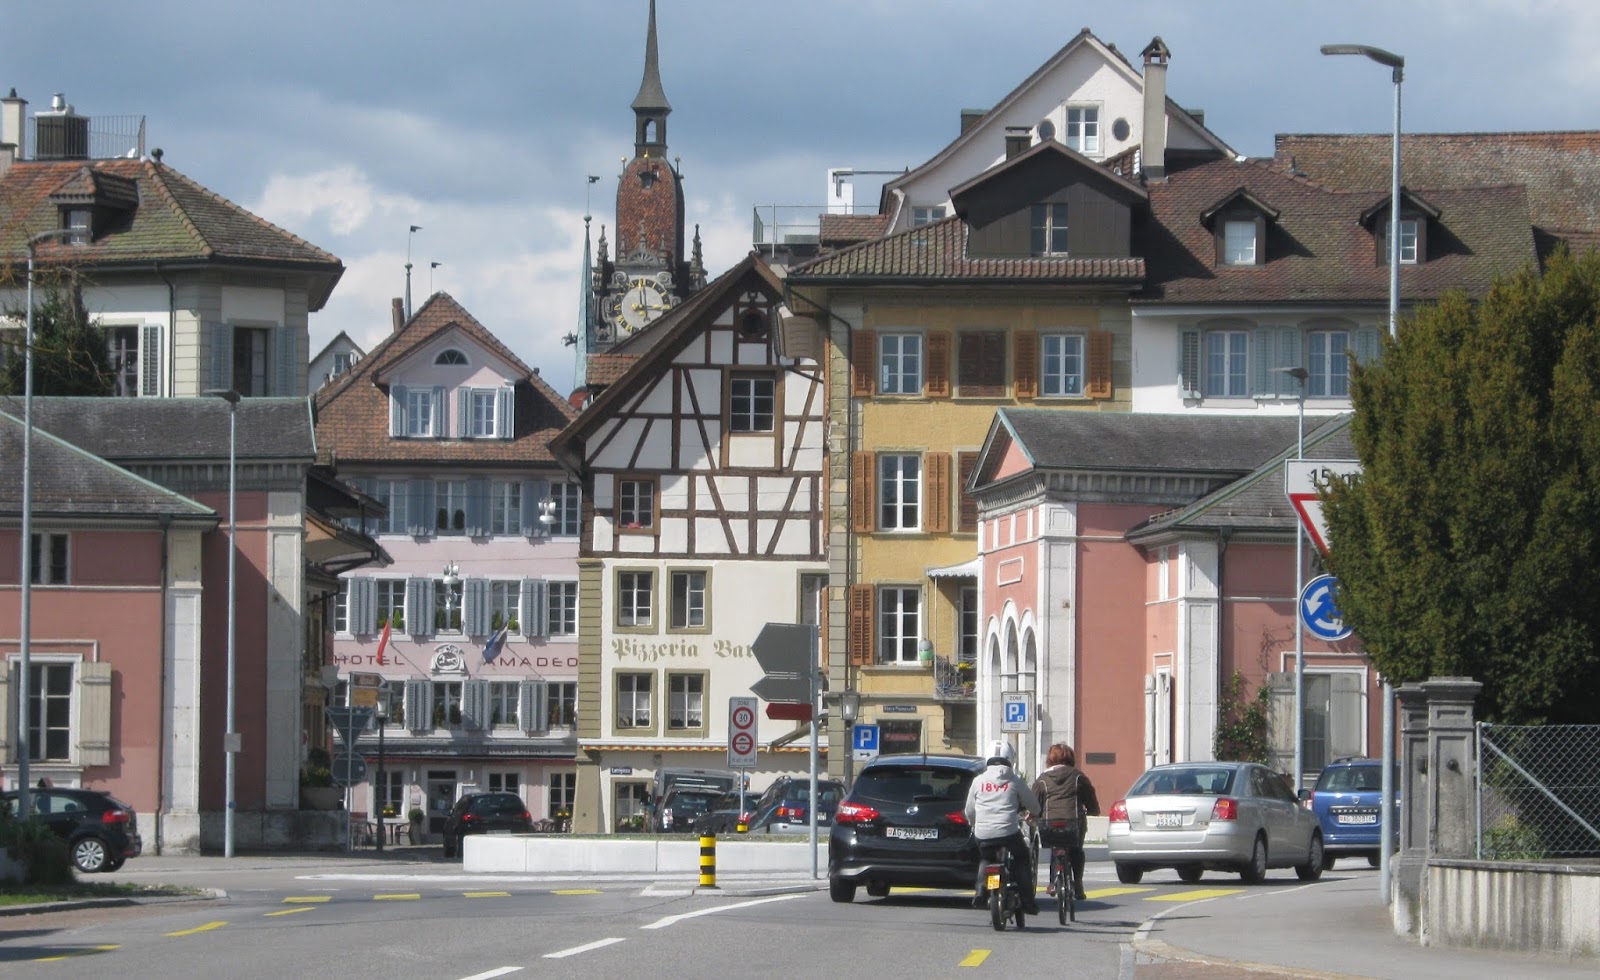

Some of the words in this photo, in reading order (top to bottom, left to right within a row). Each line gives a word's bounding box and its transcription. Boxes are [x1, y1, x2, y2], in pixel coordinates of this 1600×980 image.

[612, 639, 698, 662] Pizzeria
[335, 655, 405, 665] HOTEL
[739, 713, 748, 722] 30
[1009, 704, 1020, 720] P
[860, 729, 873, 747] P
[893, 828, 902, 836] AG
